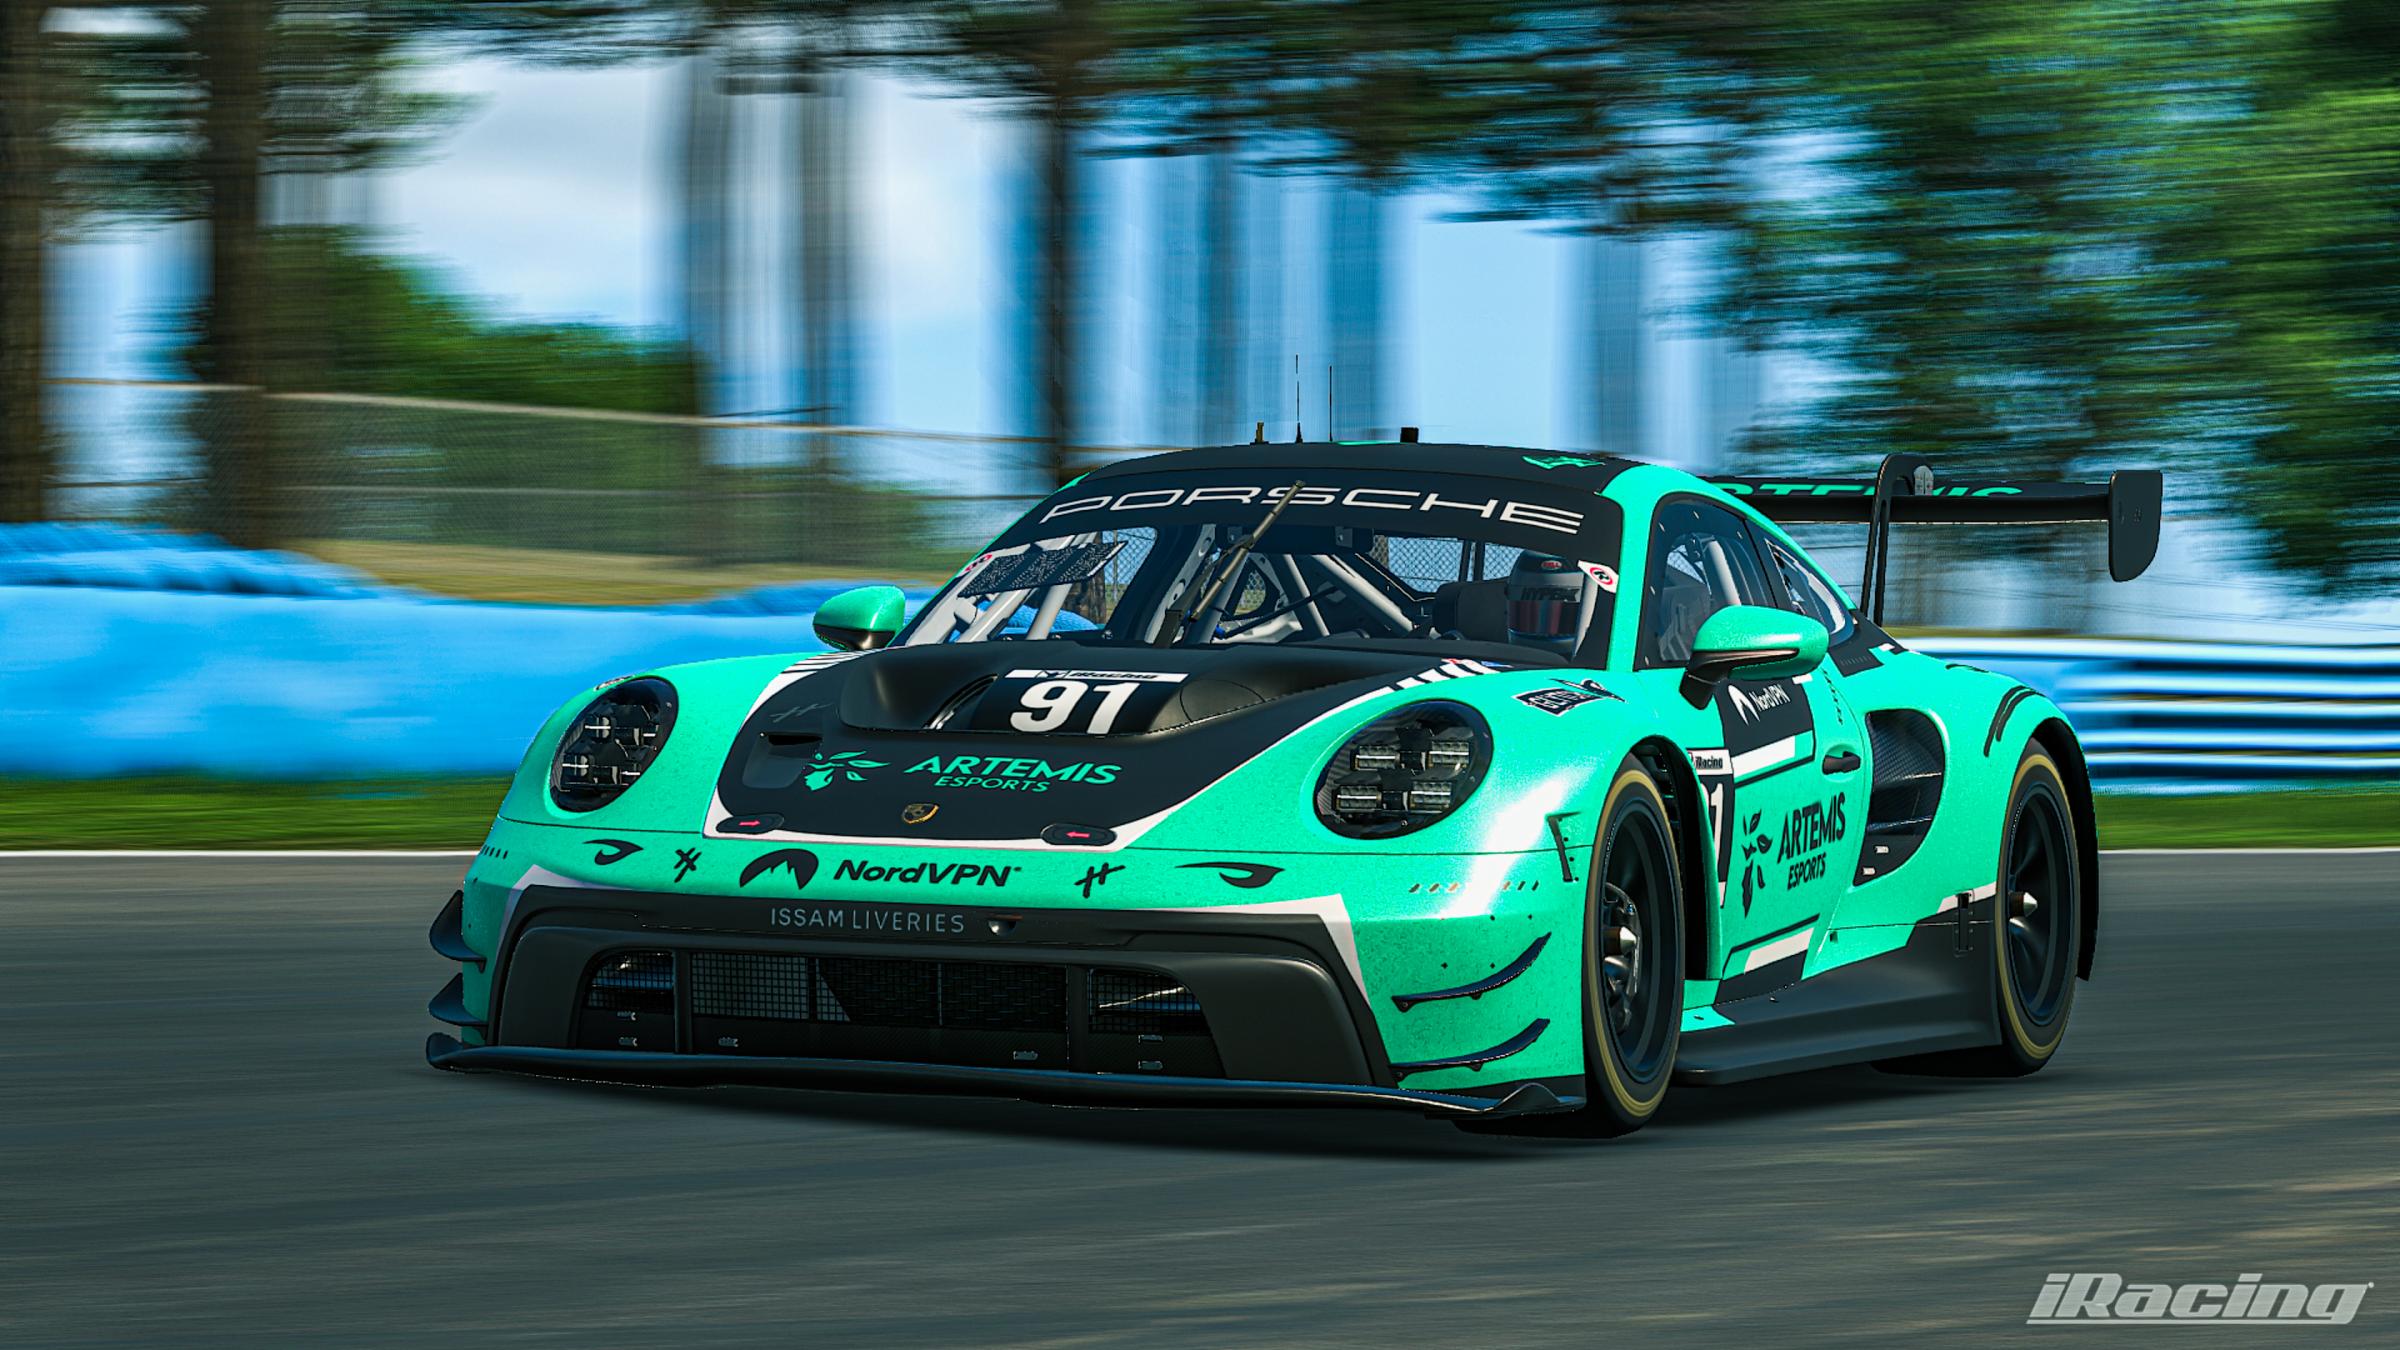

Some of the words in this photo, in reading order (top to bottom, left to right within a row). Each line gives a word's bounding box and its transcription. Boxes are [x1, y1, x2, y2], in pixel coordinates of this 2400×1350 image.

[1039, 485, 1585, 535] PORSCHE
[1010, 680, 1141, 735] 91
[1749, 683, 1791, 712] NordVPN
[903, 755, 1122, 785] ARTEMIS
[1695, 755, 1723, 770] iRacing
[934, 776, 1051, 793] ESPORTS
[1777, 792, 1846, 865] ARTEMIS
[1787, 852, 1827, 891] ESPORTS
[770, 908, 844, 927] ISSAM
[852, 910, 965, 933] LIVERIES
